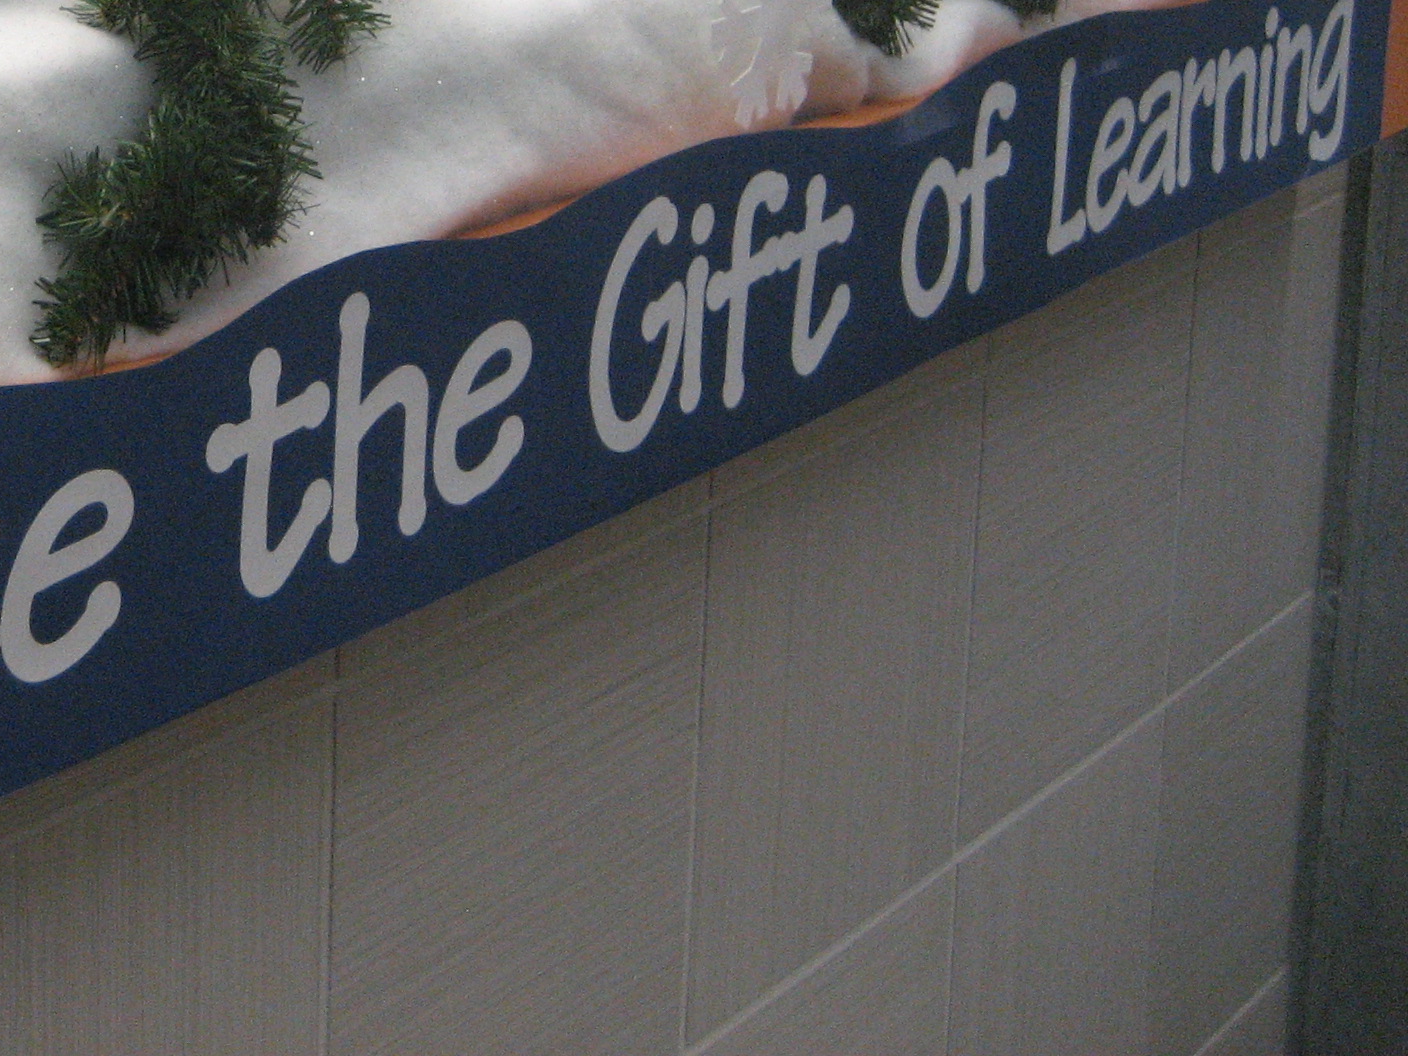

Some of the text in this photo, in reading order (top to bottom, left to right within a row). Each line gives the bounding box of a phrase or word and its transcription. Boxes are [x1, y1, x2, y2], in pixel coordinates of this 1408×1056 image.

[205, 291, 533, 598] the
[589, 169, 855, 453] Gift
[900, 81, 1017, 319] of
